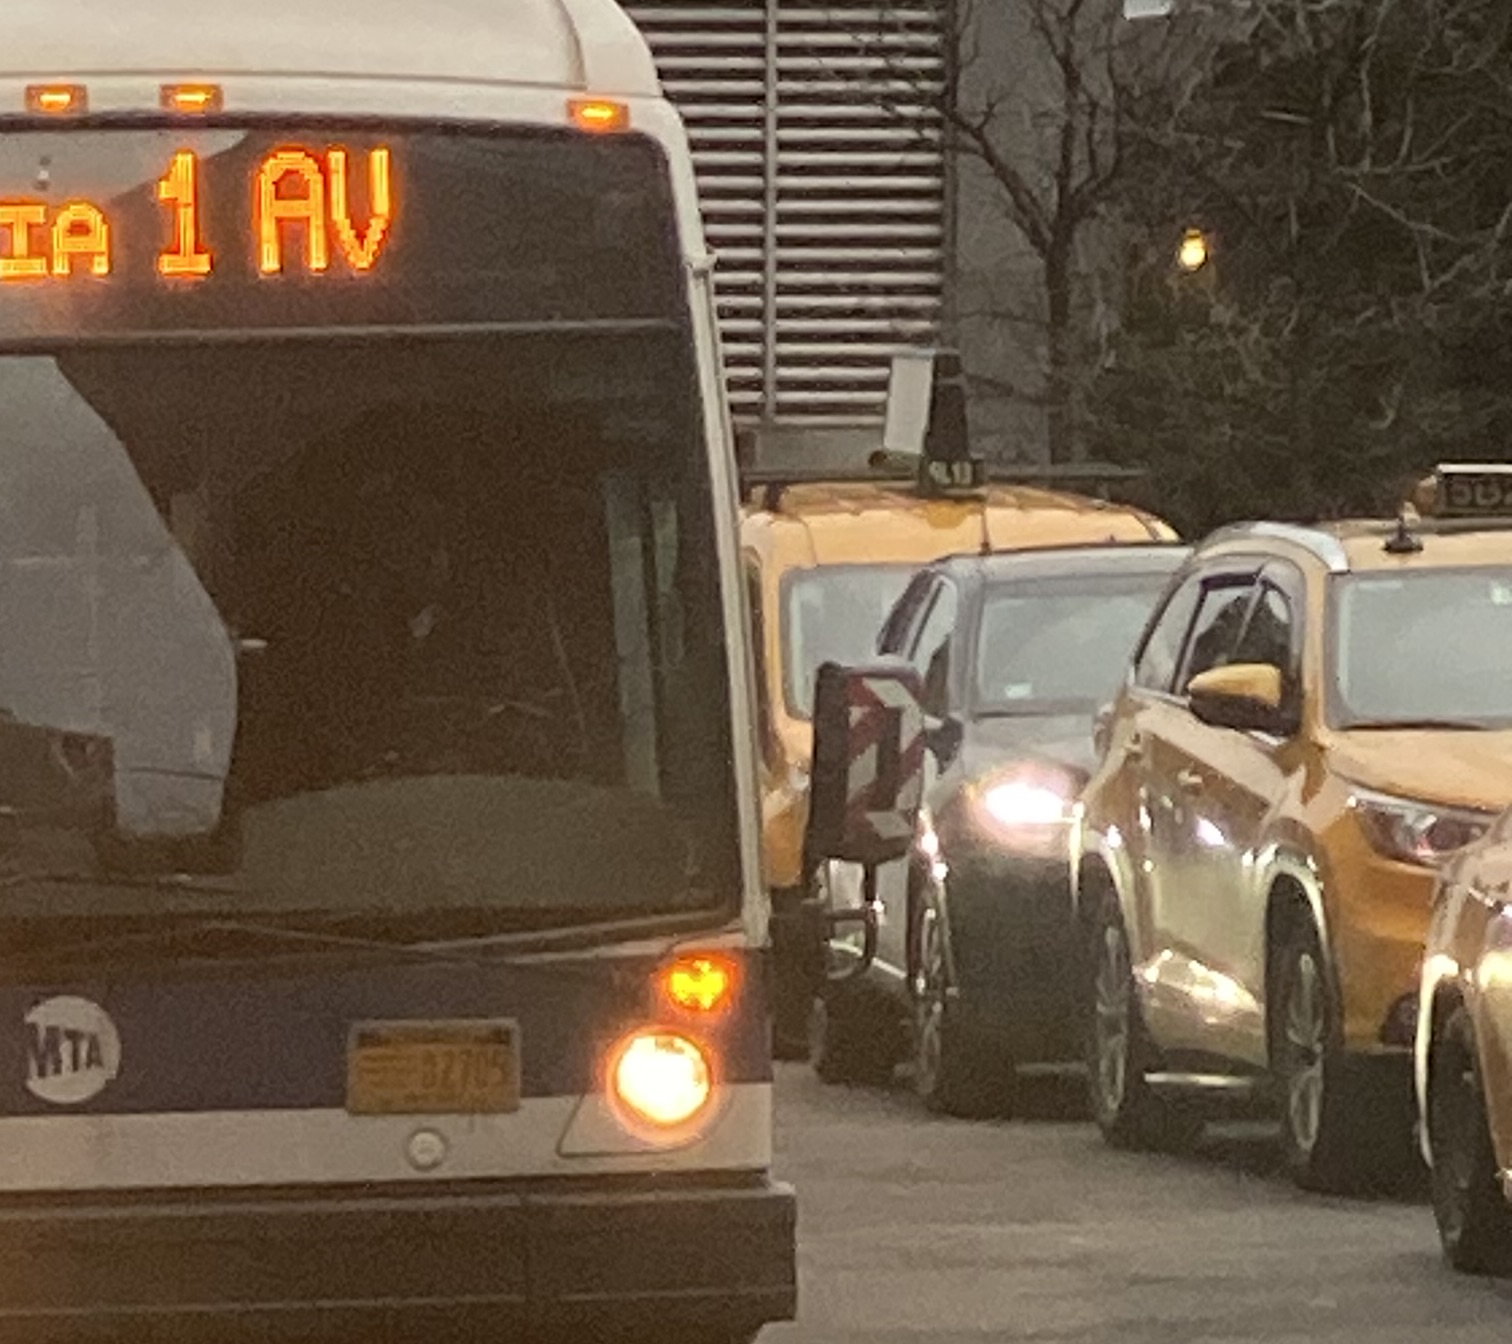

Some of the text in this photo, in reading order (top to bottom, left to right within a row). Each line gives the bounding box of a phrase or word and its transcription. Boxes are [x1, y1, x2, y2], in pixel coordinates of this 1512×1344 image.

[155, 145, 214, 278] 1
[252, 144, 392, 275] AV
[26, 1020, 107, 1079] MTA
